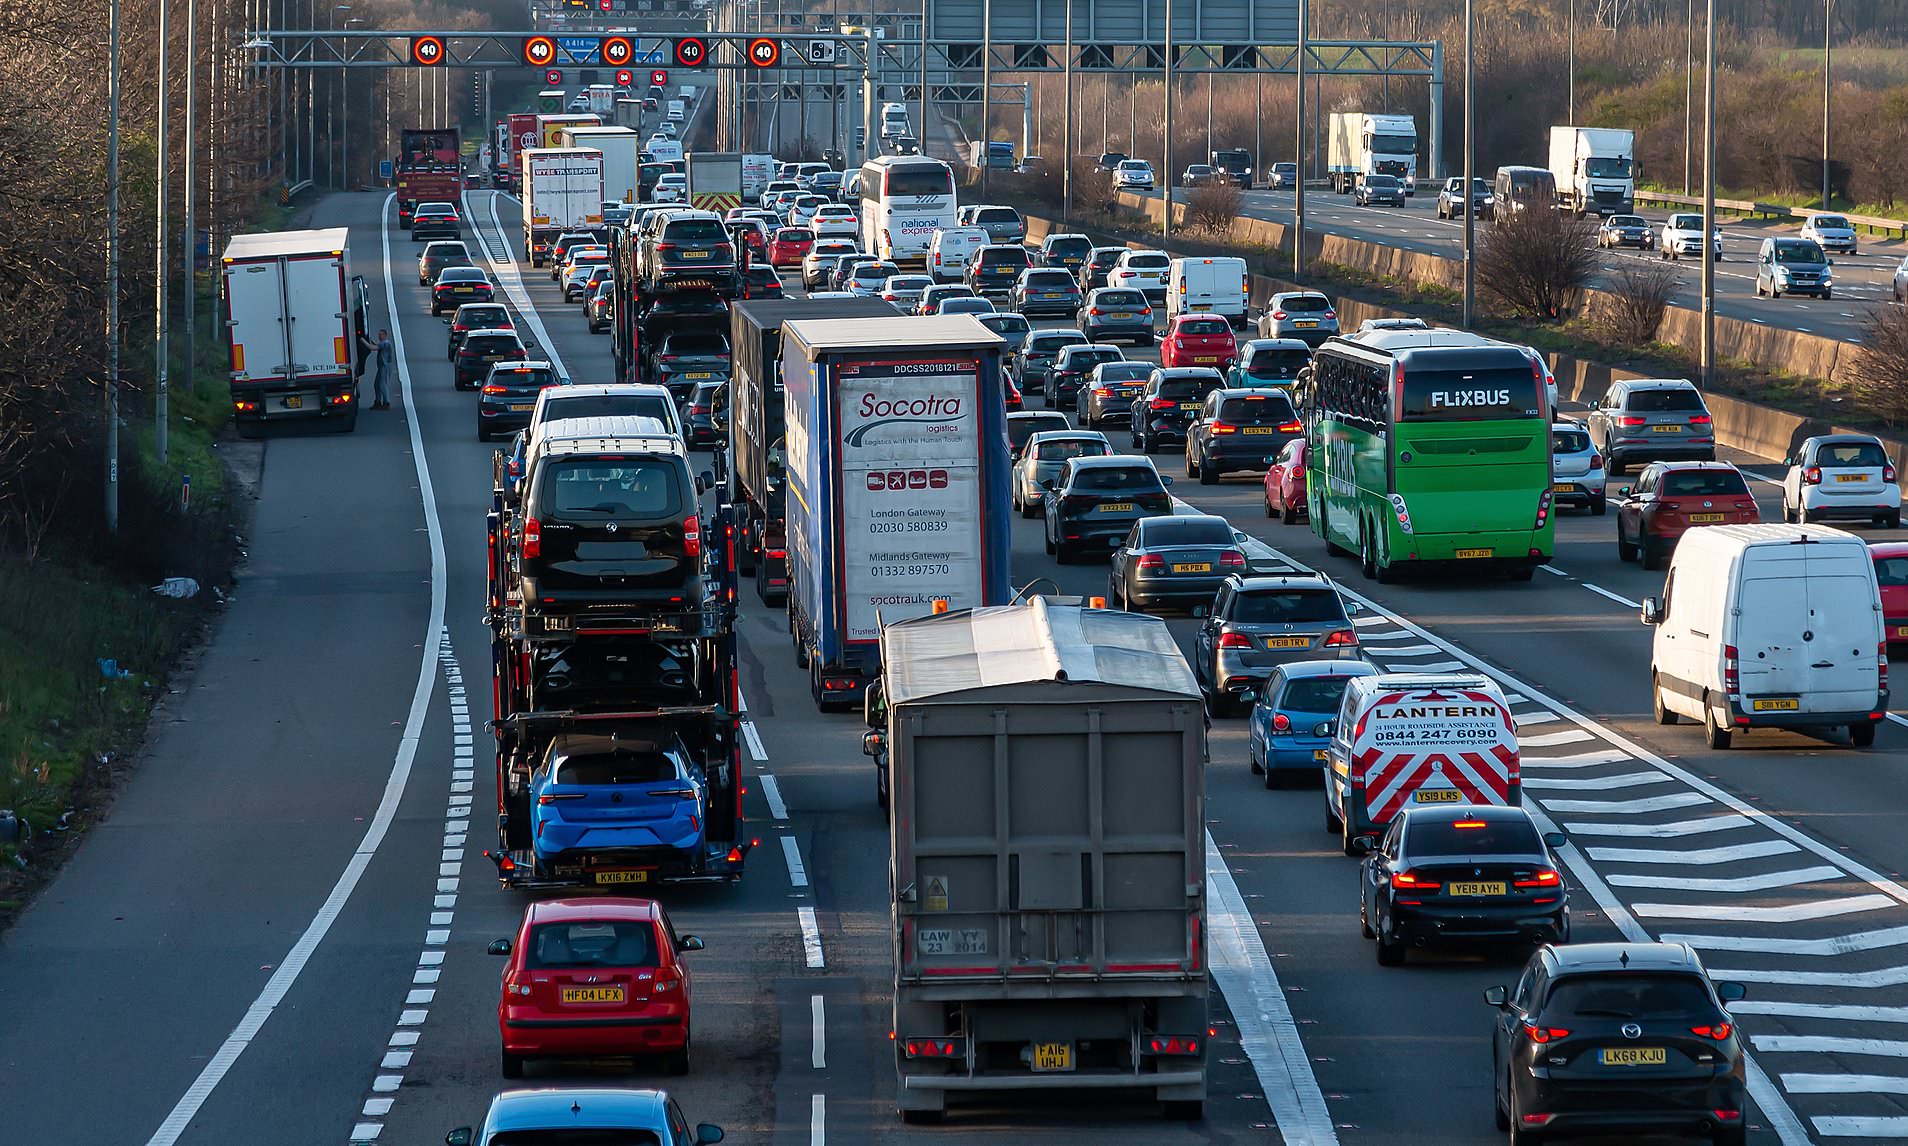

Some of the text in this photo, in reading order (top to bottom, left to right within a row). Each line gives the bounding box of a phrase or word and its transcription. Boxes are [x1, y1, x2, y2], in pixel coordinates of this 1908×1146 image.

[421, 45, 436, 56] 40
[532, 45, 547, 56] 40
[610, 46, 625, 56] 40
[684, 46, 698, 56] 40
[756, 46, 771, 58] 40
[901, 218, 939, 228] national
[859, 392, 961, 418] Socotra
[926, 424, 959, 434] logistics
[864, 438, 891, 446] Logistics
[908, 436, 919, 444] the
[870, 508, 946, 518] London Gateway
[869, 521, 948, 533] 02030 580839
[869, 551, 951, 562] Midlands Gateway
[871, 564, 949, 577] 01332 897570
[1375, 706, 1496, 719] LANTERN
[1375, 729, 1497, 741] 0844 247 6090
[1375, 738, 1498, 747] www.lanternrecovery.com
[1419, 791, 1458, 801] YS19 LRS
[600, 872, 642, 882] KX16 ZWH
[1455, 884, 1500, 893] YE19 AYH
[921, 931, 979, 941] LAW YY
[927, 943, 986, 953] 23 2014
[567, 990, 619, 1000] HF04 LFX
[1039, 1045, 1065, 1056] FA16
[1605, 1049, 1664, 1062] LK68 KJU
[1041, 1058, 1064, 1068] UHJ
